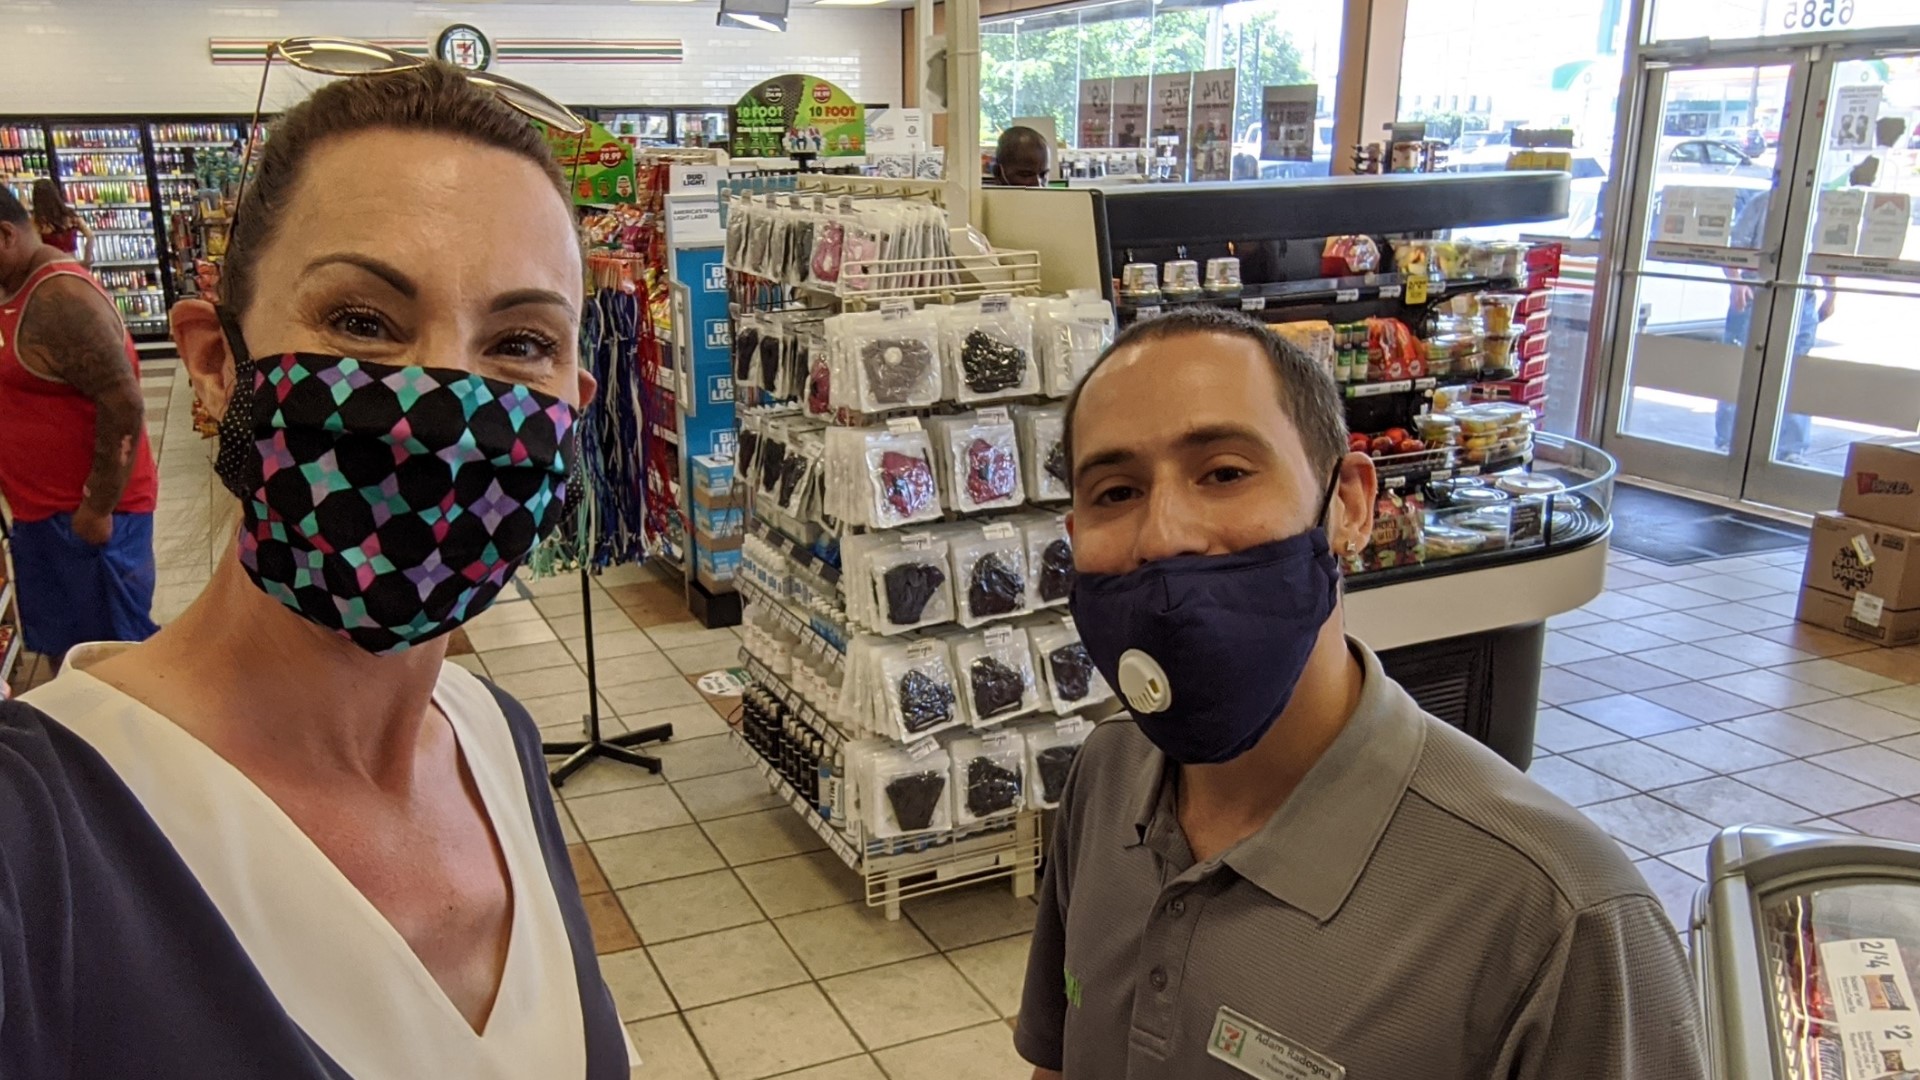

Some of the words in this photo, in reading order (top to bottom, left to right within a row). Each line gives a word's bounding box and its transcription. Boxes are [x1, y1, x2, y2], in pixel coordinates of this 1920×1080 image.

[736, 107, 750, 117] 10
[752, 106, 784, 117] FOOT
[809, 106, 823, 117] 10
[825, 106, 857, 117] FOOT
[600, 153, 621, 161] $9.99
[1834, 556, 1866, 570] SOU
[1832, 565, 1873, 584] PATCH
[1860, 941, 1891, 969] 2/$4
[1884, 1024, 1912, 1040] $2
[1255, 1033, 1284, 1054] Adam
[1287, 1050, 1331, 1079] Radogna
